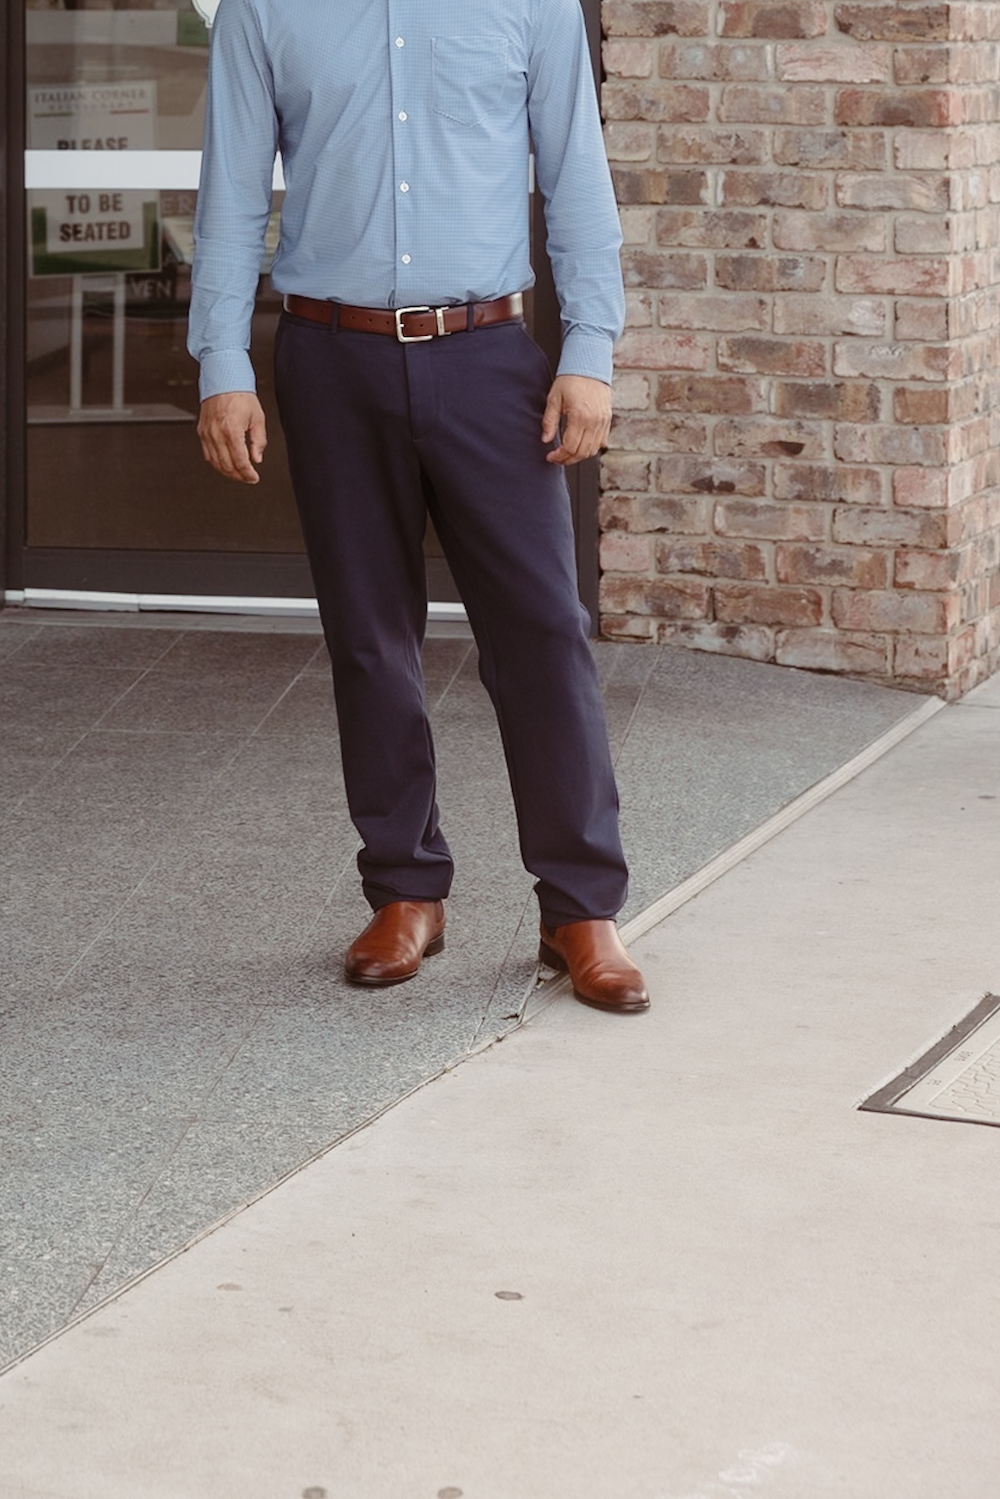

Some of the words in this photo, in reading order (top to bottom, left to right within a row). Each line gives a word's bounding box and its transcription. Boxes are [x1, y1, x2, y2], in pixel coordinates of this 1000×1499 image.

[66, 194, 90, 214] TO
[98, 193, 122, 213] BE
[59, 220, 131, 243] SEATED
